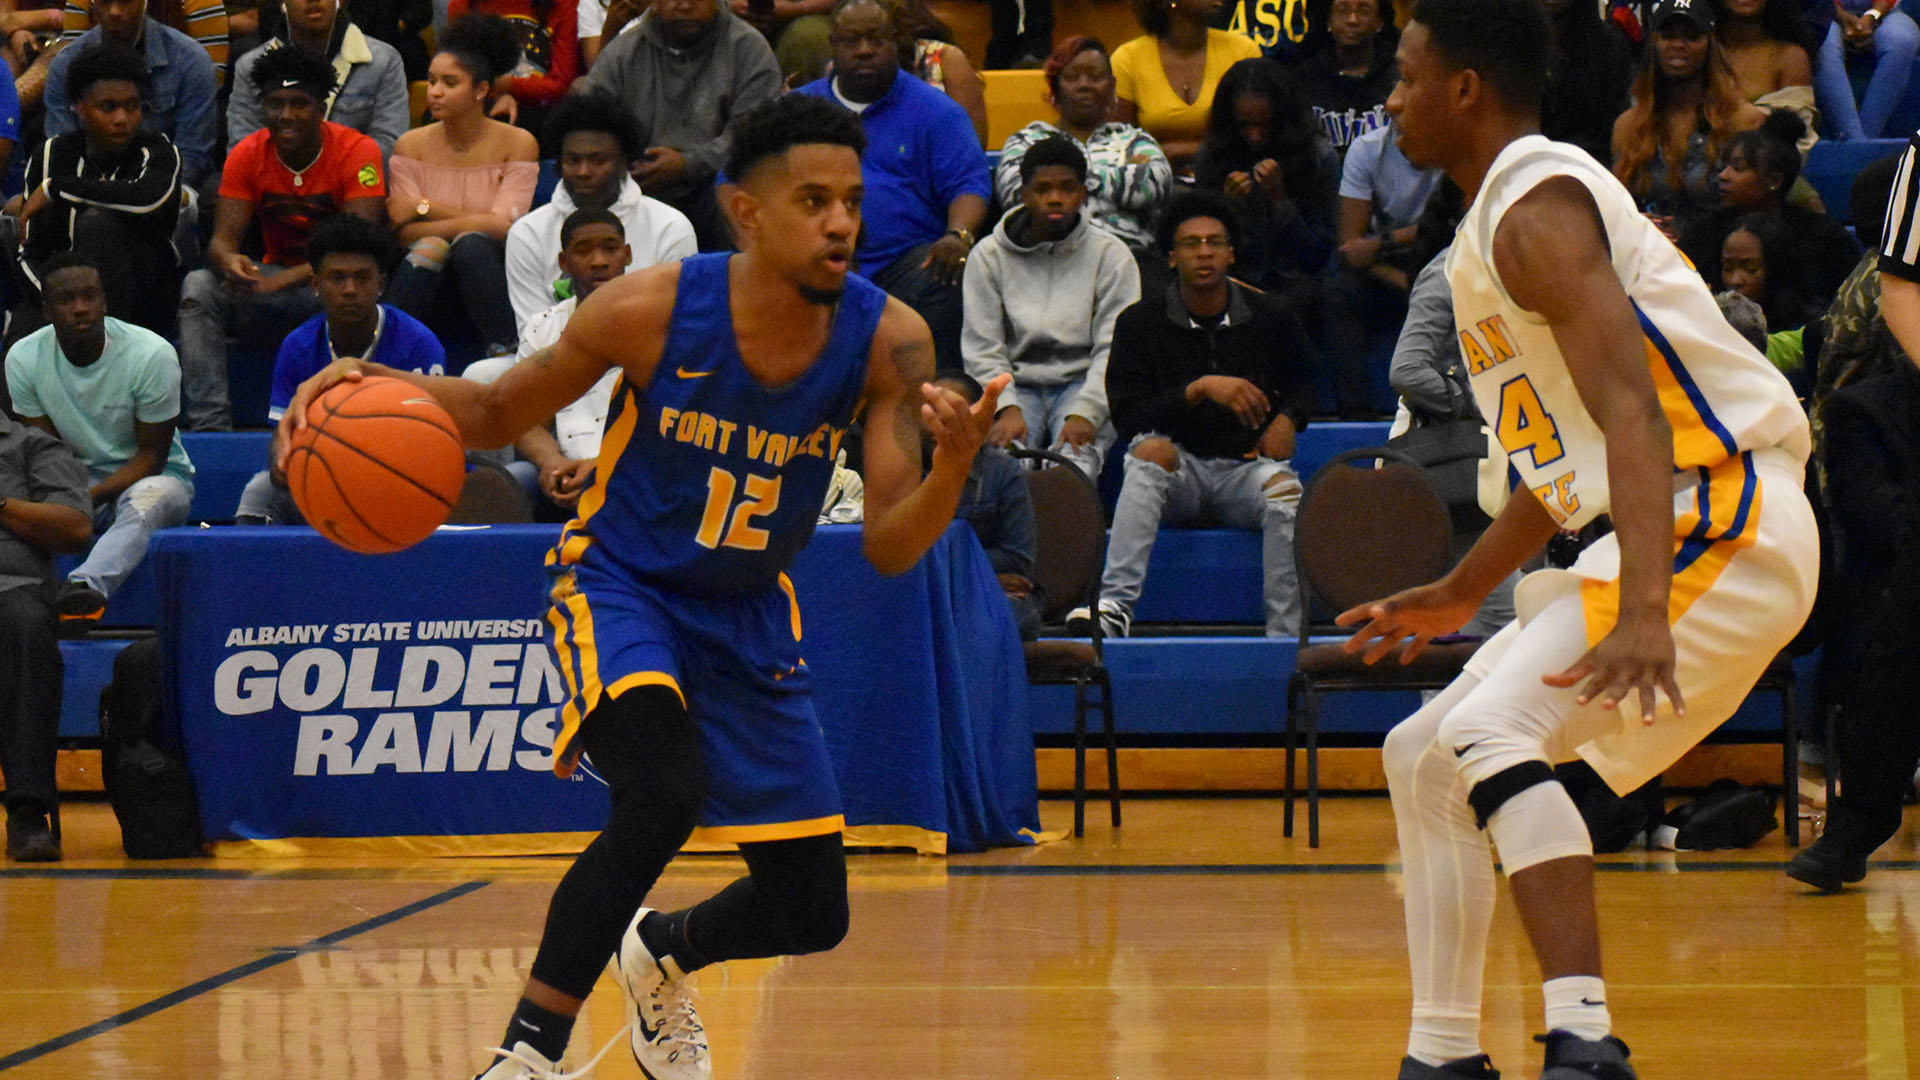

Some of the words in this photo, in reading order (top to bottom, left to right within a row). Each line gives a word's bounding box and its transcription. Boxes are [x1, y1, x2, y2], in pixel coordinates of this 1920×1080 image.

[1228, 0, 1309, 47] ASU
[659, 406, 737, 455] FORT
[1496, 373, 1565, 469] 4
[694, 466, 782, 550] 12
[225, 624, 328, 647] ALBANY
[333, 621, 411, 643] STATE
[417, 619, 543, 640] UNIVERSIT
[214, 643, 564, 716] GOLDEN
[293, 707, 557, 775] RAMS
